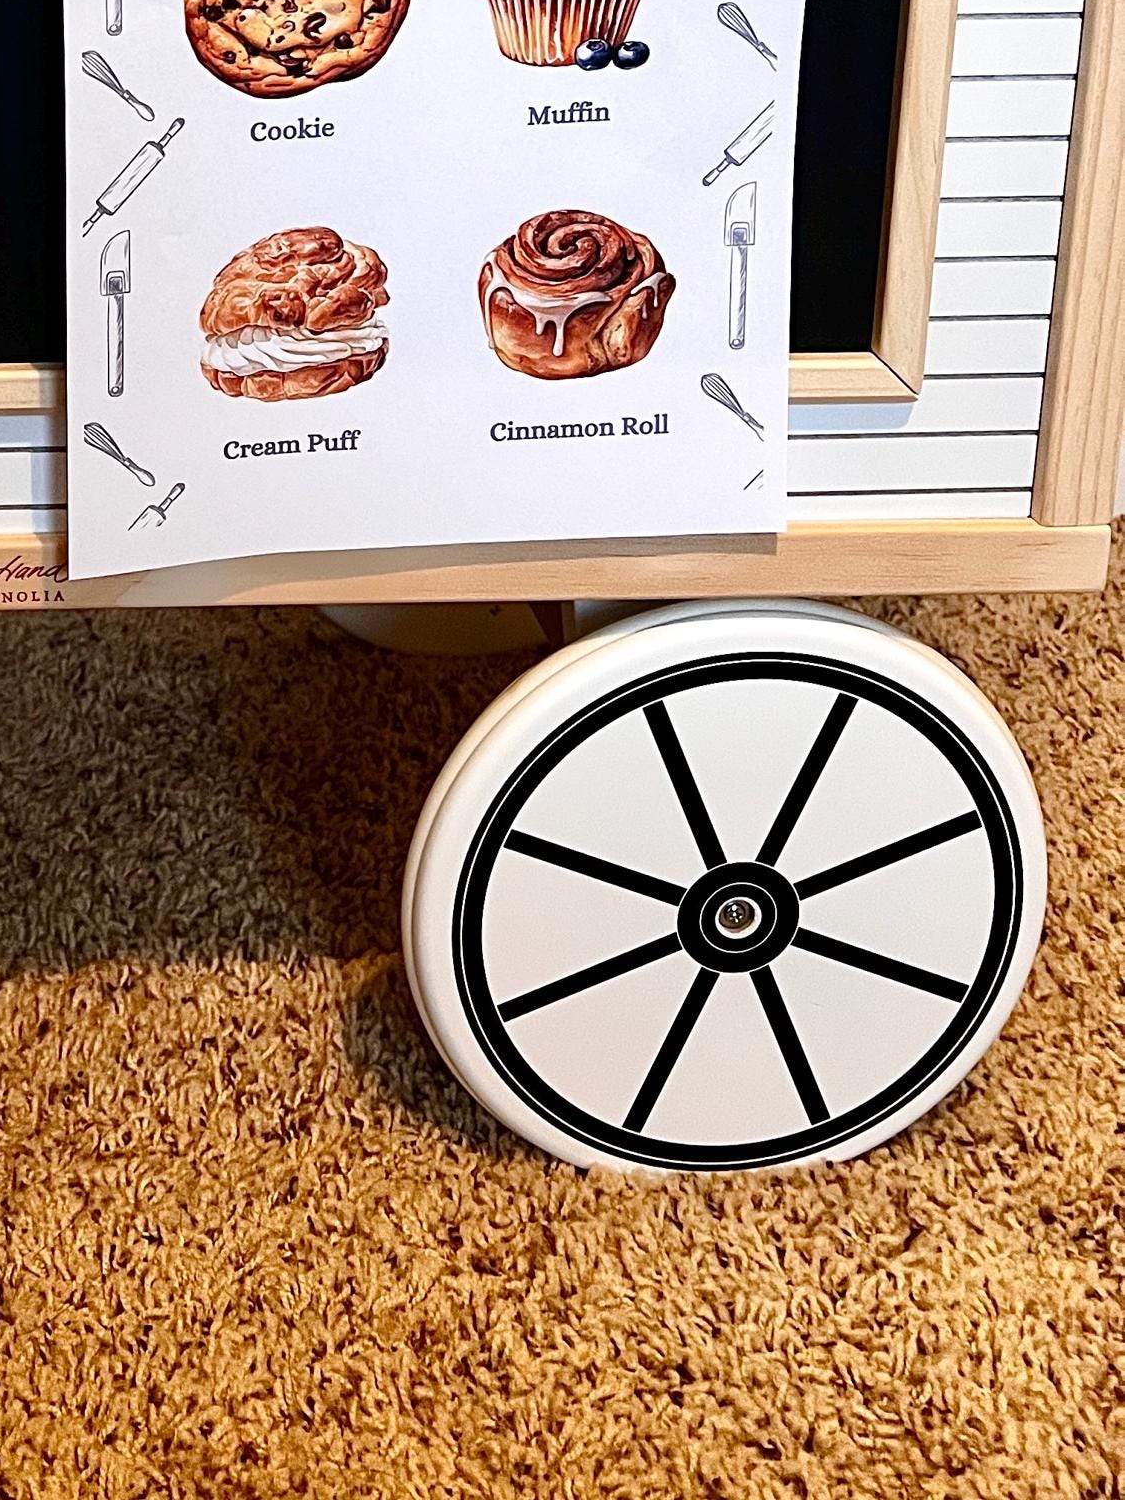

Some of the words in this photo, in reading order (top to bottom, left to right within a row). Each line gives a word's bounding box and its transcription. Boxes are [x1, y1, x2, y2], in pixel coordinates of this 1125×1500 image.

[527, 101, 611, 126] Muffin
[250, 117, 335, 142] Cookie
[490, 420, 613, 443] Cinnamon
[621, 413, 670, 436] Roll
[224, 439, 301, 460] Cream
[307, 430, 361, 453] Puff
